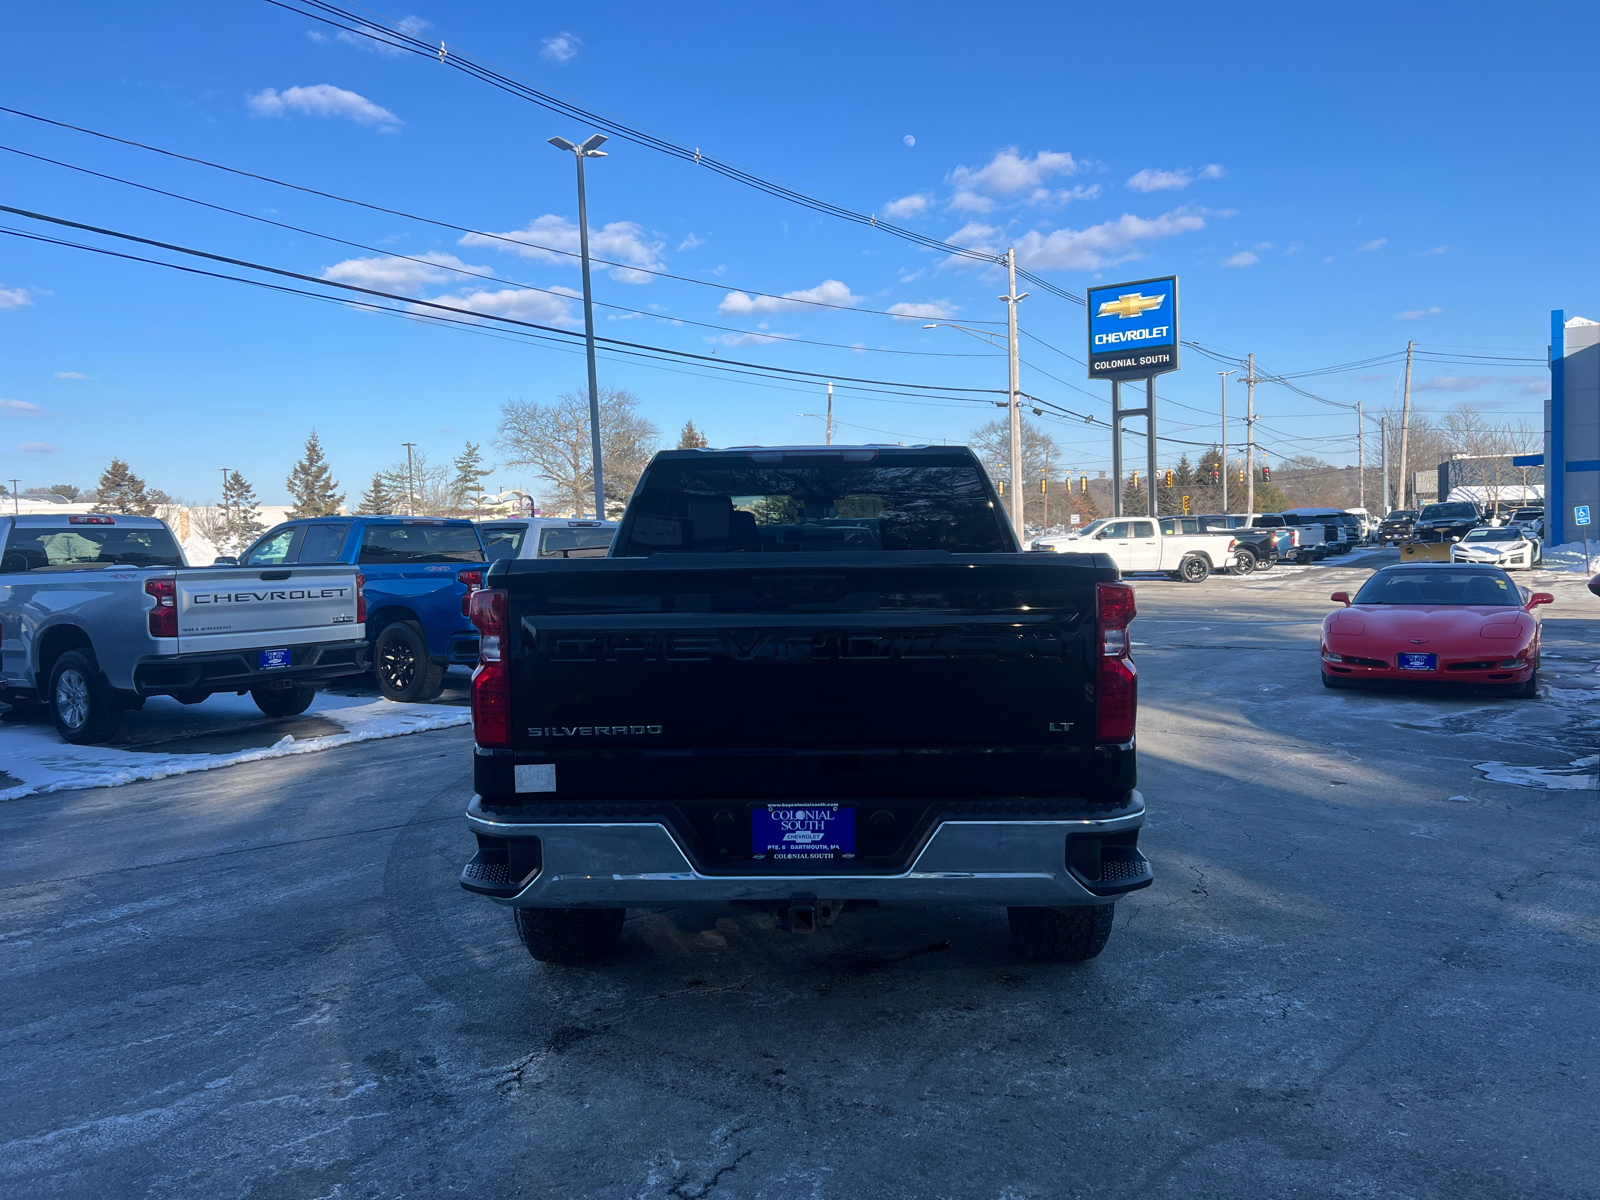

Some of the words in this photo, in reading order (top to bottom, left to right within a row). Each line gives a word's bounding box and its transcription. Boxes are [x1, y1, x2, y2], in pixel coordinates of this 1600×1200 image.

[1095, 326, 1169, 345] CHEVROLET
[1094, 358, 1137, 370] COLONIAL
[1139, 354, 1170, 365] SOUTH
[193, 588, 348, 604] CHEVROLET
[527, 725, 663, 737] SILVERADO
[1049, 722, 1074, 731] LT
[771, 810, 835, 820] COLONIAL
[781, 820, 825, 830] SOUTH
